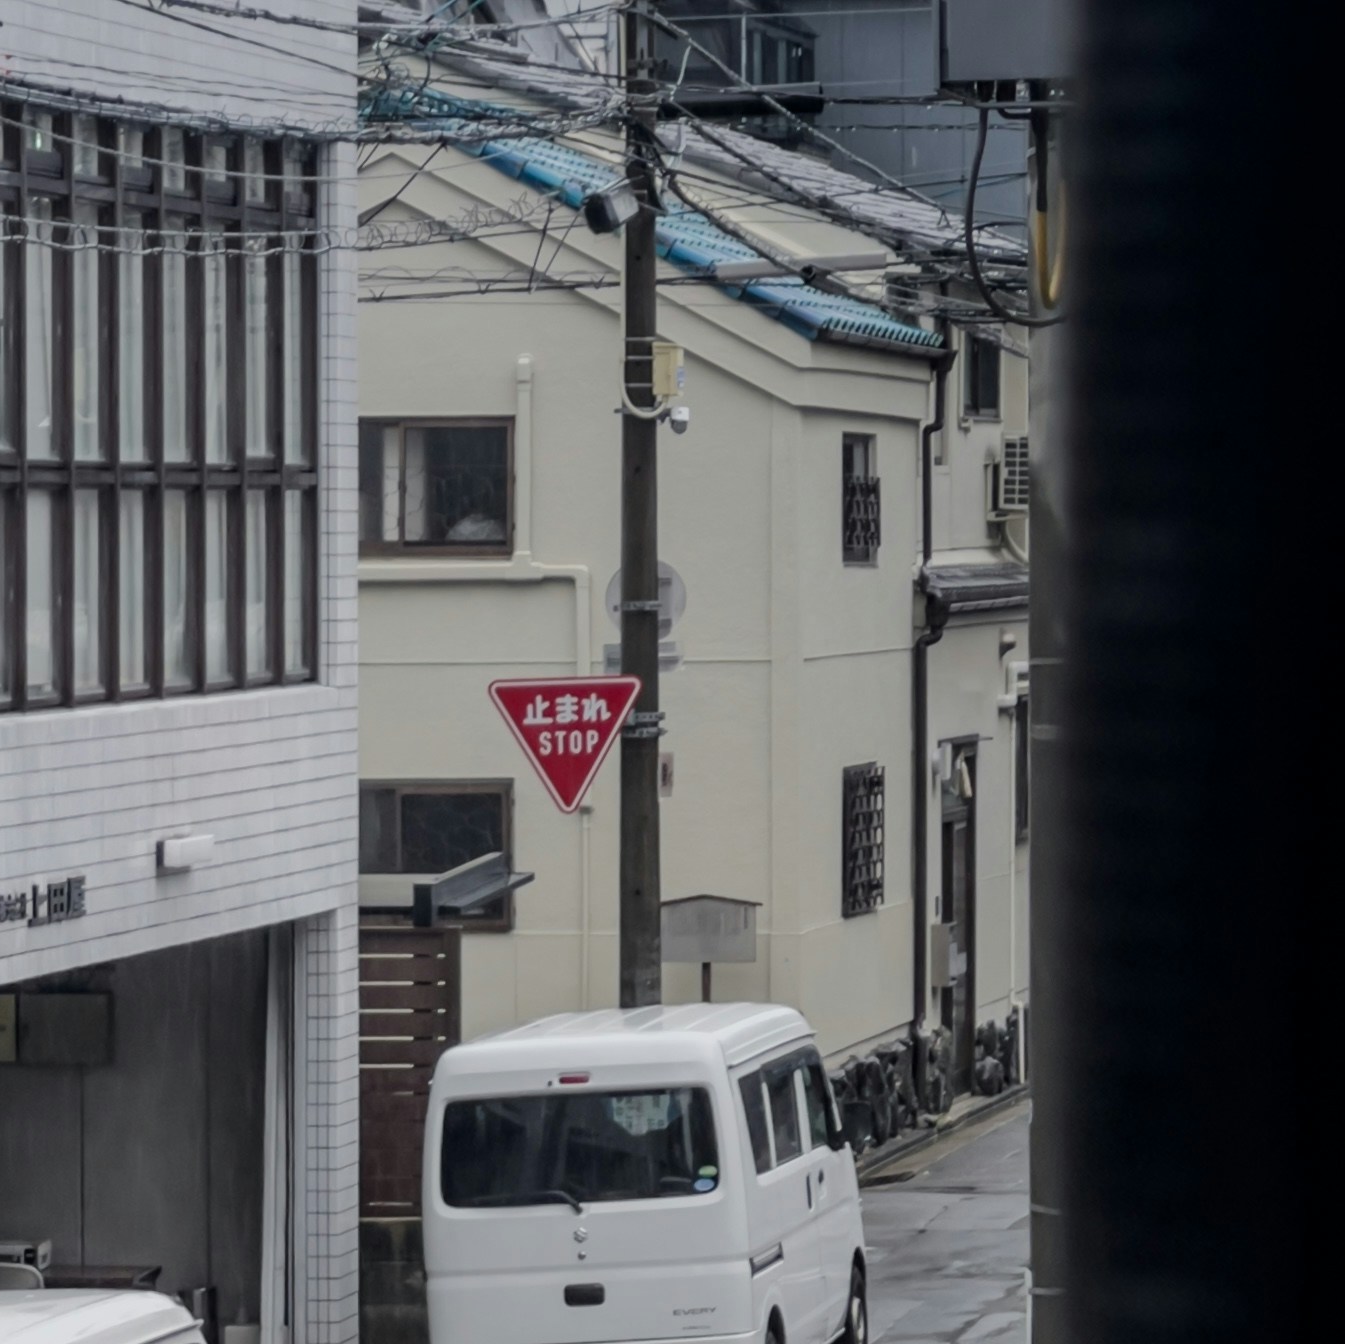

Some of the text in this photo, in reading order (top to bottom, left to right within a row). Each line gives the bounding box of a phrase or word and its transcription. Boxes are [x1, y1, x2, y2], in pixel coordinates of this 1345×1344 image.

[522, 692, 612, 725] 止まれ
[538, 729, 599, 755] STOP
